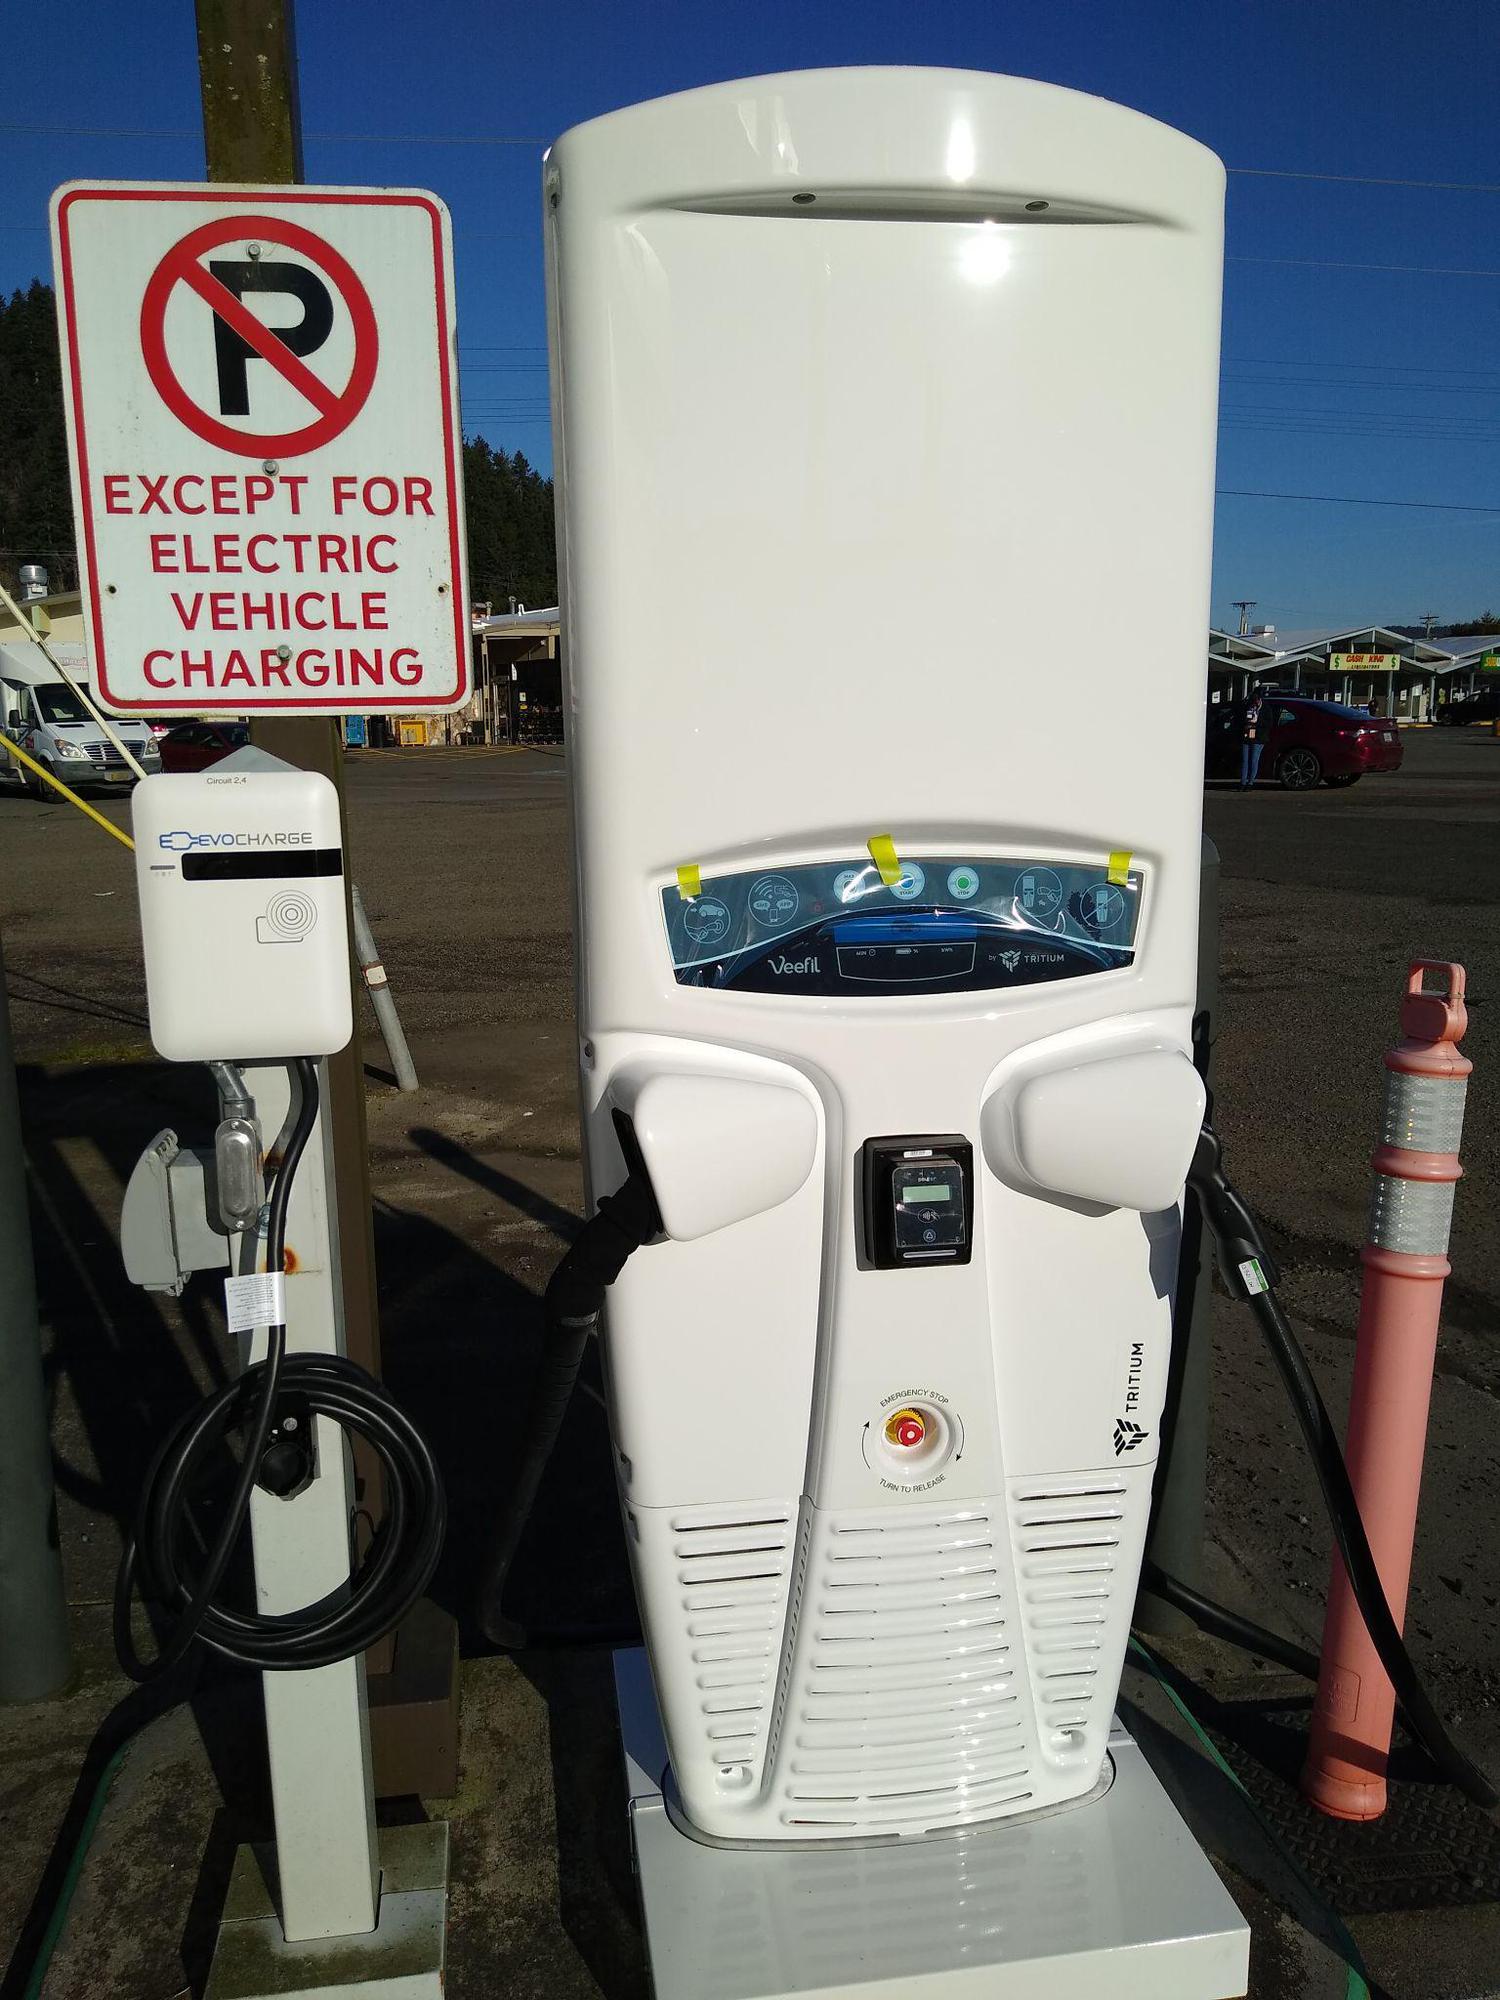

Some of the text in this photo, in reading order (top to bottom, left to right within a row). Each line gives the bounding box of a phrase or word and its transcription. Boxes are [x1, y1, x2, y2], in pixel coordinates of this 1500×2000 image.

[103, 475, 435, 516] EXCEPT FOR
[150, 534, 400, 574] ELECTRIC
[170, 592, 389, 631] VEHICLE
[143, 647, 424, 689] CHARGING
[1345, 655, 1365, 663] CASH
[1368, 655, 1385, 663] KING
[206, 777, 233, 785] Circuit
[198, 832, 313, 847] EVOCHARGE
[768, 955, 821, 975] Veefil
[988, 953, 1065, 964] by TRITIUM
[1125, 1343, 1144, 1412] TRITIUM
[880, 1388, 949, 1408] EMERGENCY STOP
[879, 1473, 946, 1493] TURN TO RELEASE
